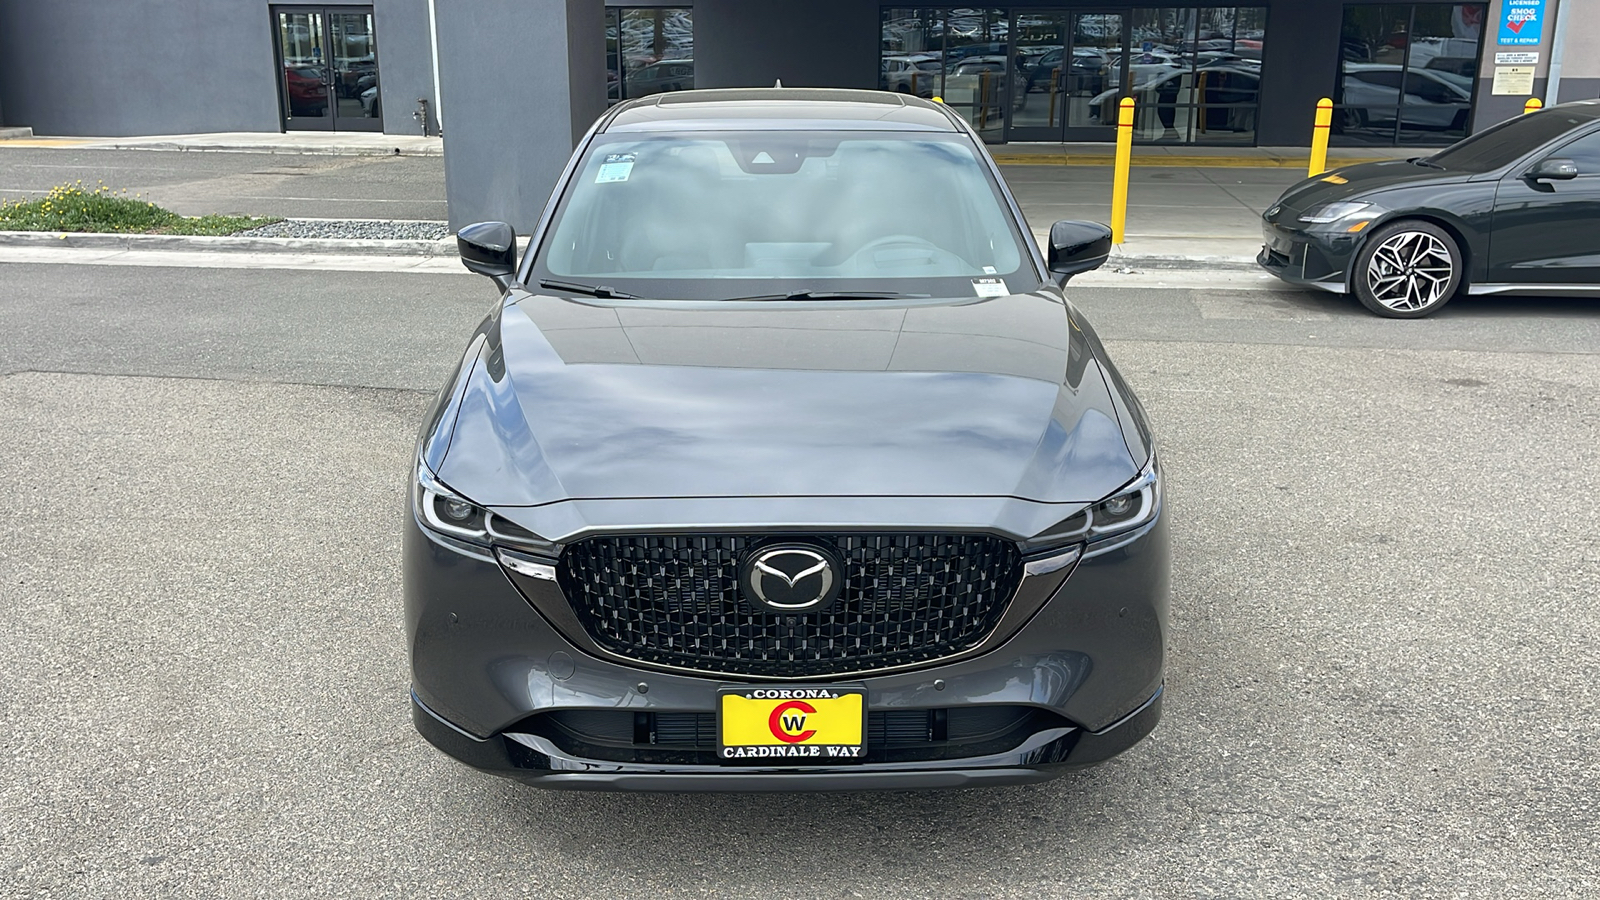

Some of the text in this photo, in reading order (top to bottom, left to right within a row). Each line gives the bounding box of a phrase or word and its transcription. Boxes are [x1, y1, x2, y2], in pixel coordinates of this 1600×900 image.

[753, 689, 831, 699] CORONA
[723, 746, 861, 758] CARDINALE WAY
